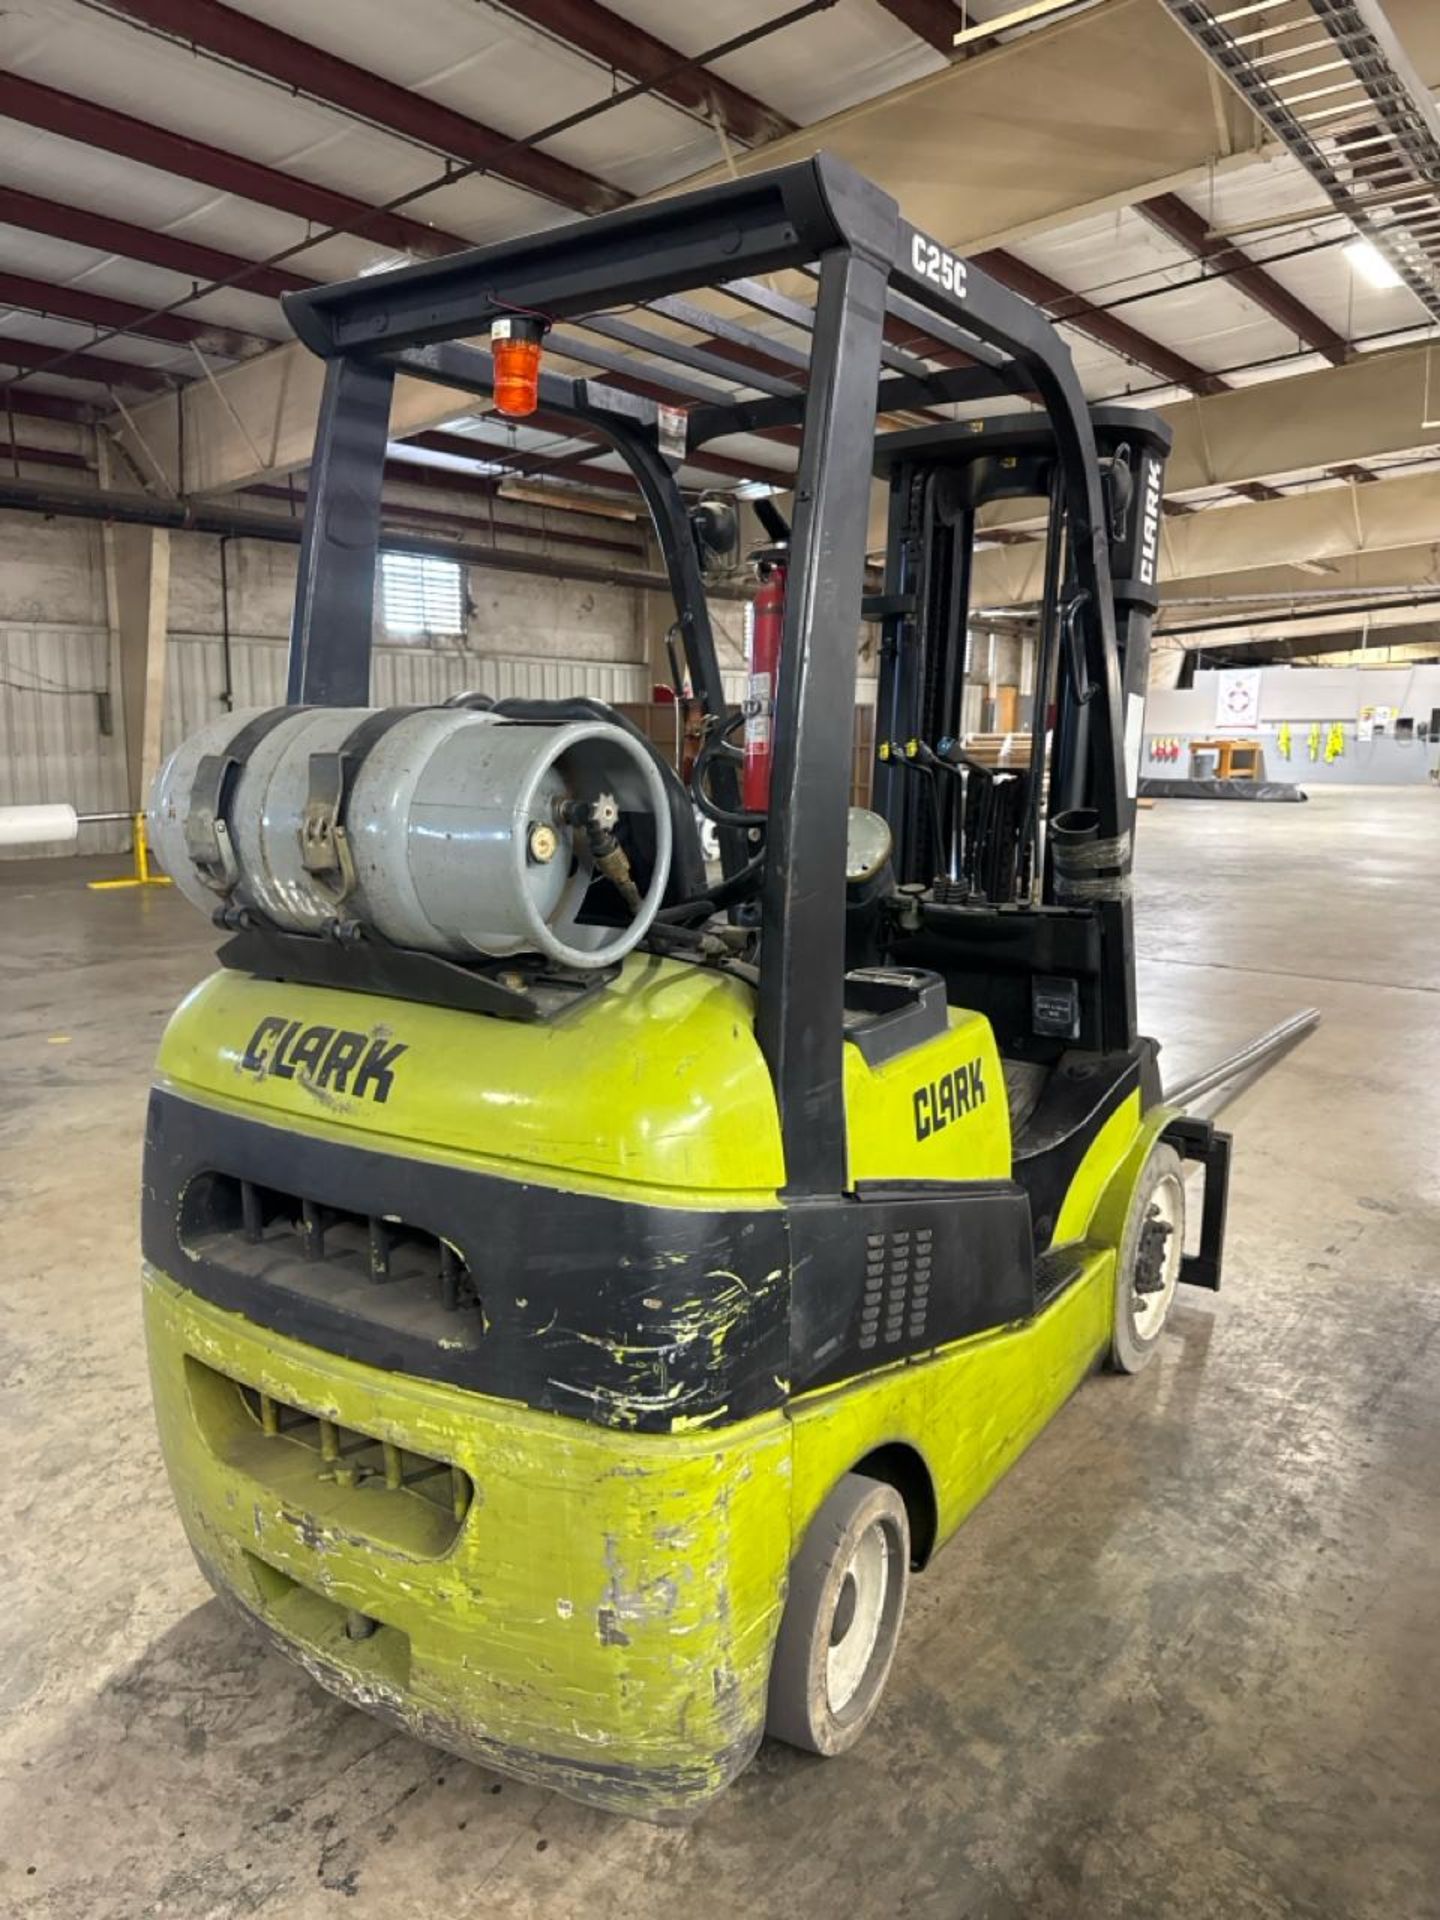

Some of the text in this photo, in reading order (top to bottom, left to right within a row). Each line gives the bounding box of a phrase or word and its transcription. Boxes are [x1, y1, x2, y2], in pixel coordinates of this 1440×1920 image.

[911, 233, 967, 298] C25C
[1139, 458, 1163, 585] CLARK
[242, 1016, 408, 1104] CLARK
[913, 1057, 985, 1142] CLARK
